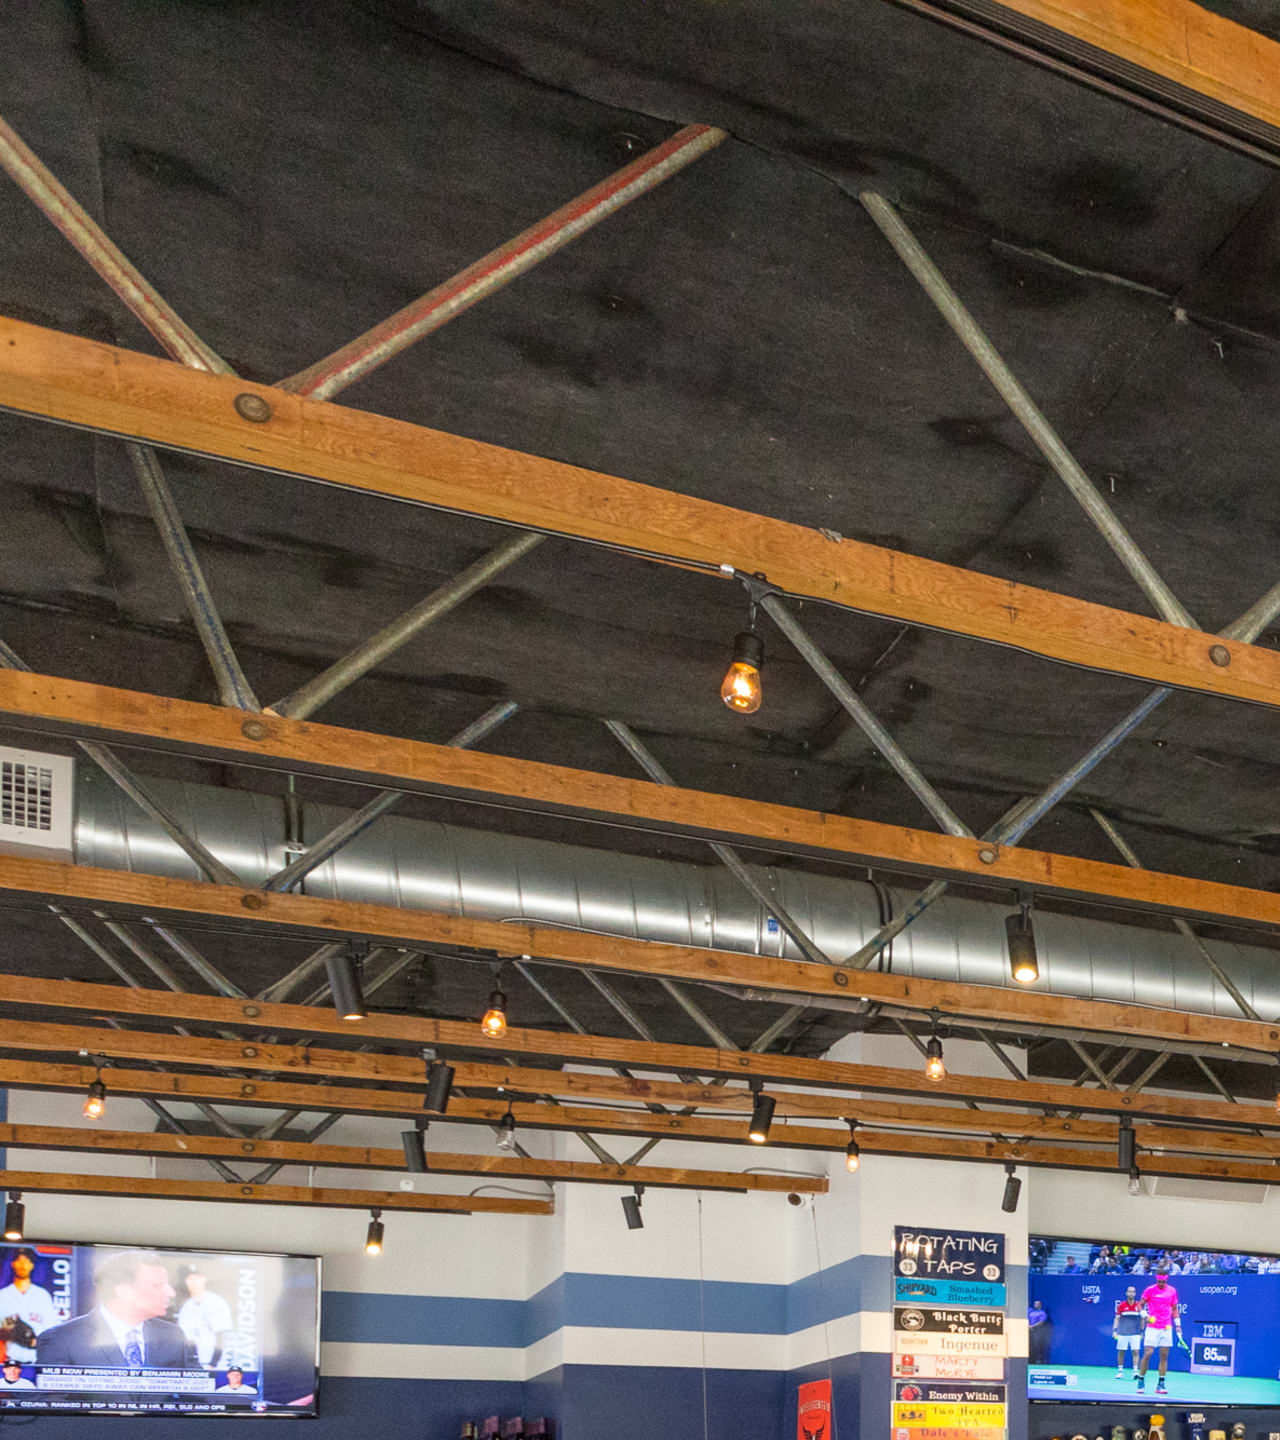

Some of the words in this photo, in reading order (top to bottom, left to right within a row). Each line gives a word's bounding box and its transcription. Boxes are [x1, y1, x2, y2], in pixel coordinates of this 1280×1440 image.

[901, 1233, 998, 1254] ROTATING
[924, 1259, 976, 1275] TAPS
[897, 1283, 937, 1296] SHIPYARD
[949, 1284, 993, 1295] Smashed
[1082, 1286, 1101, 1294] USTA
[1199, 1285, 1238, 1296] usopen.org
[947, 1294, 995, 1305] Blueberry
[236, 1268, 258, 1369] DAVIDSON
[932, 1312, 968, 1323] Black
[948, 1324, 987, 1334] Porter
[1203, 1325, 1223, 1338] IBM
[940, 1338, 998, 1355] Ingenue
[928, 1391, 963, 1401] Enemy
[965, 1392, 999, 1401] Within
[931, 1406, 954, 1415] Two
[959, 1406, 1004, 1415] Hearted
[920, 1428, 958, 1437] Dale's
